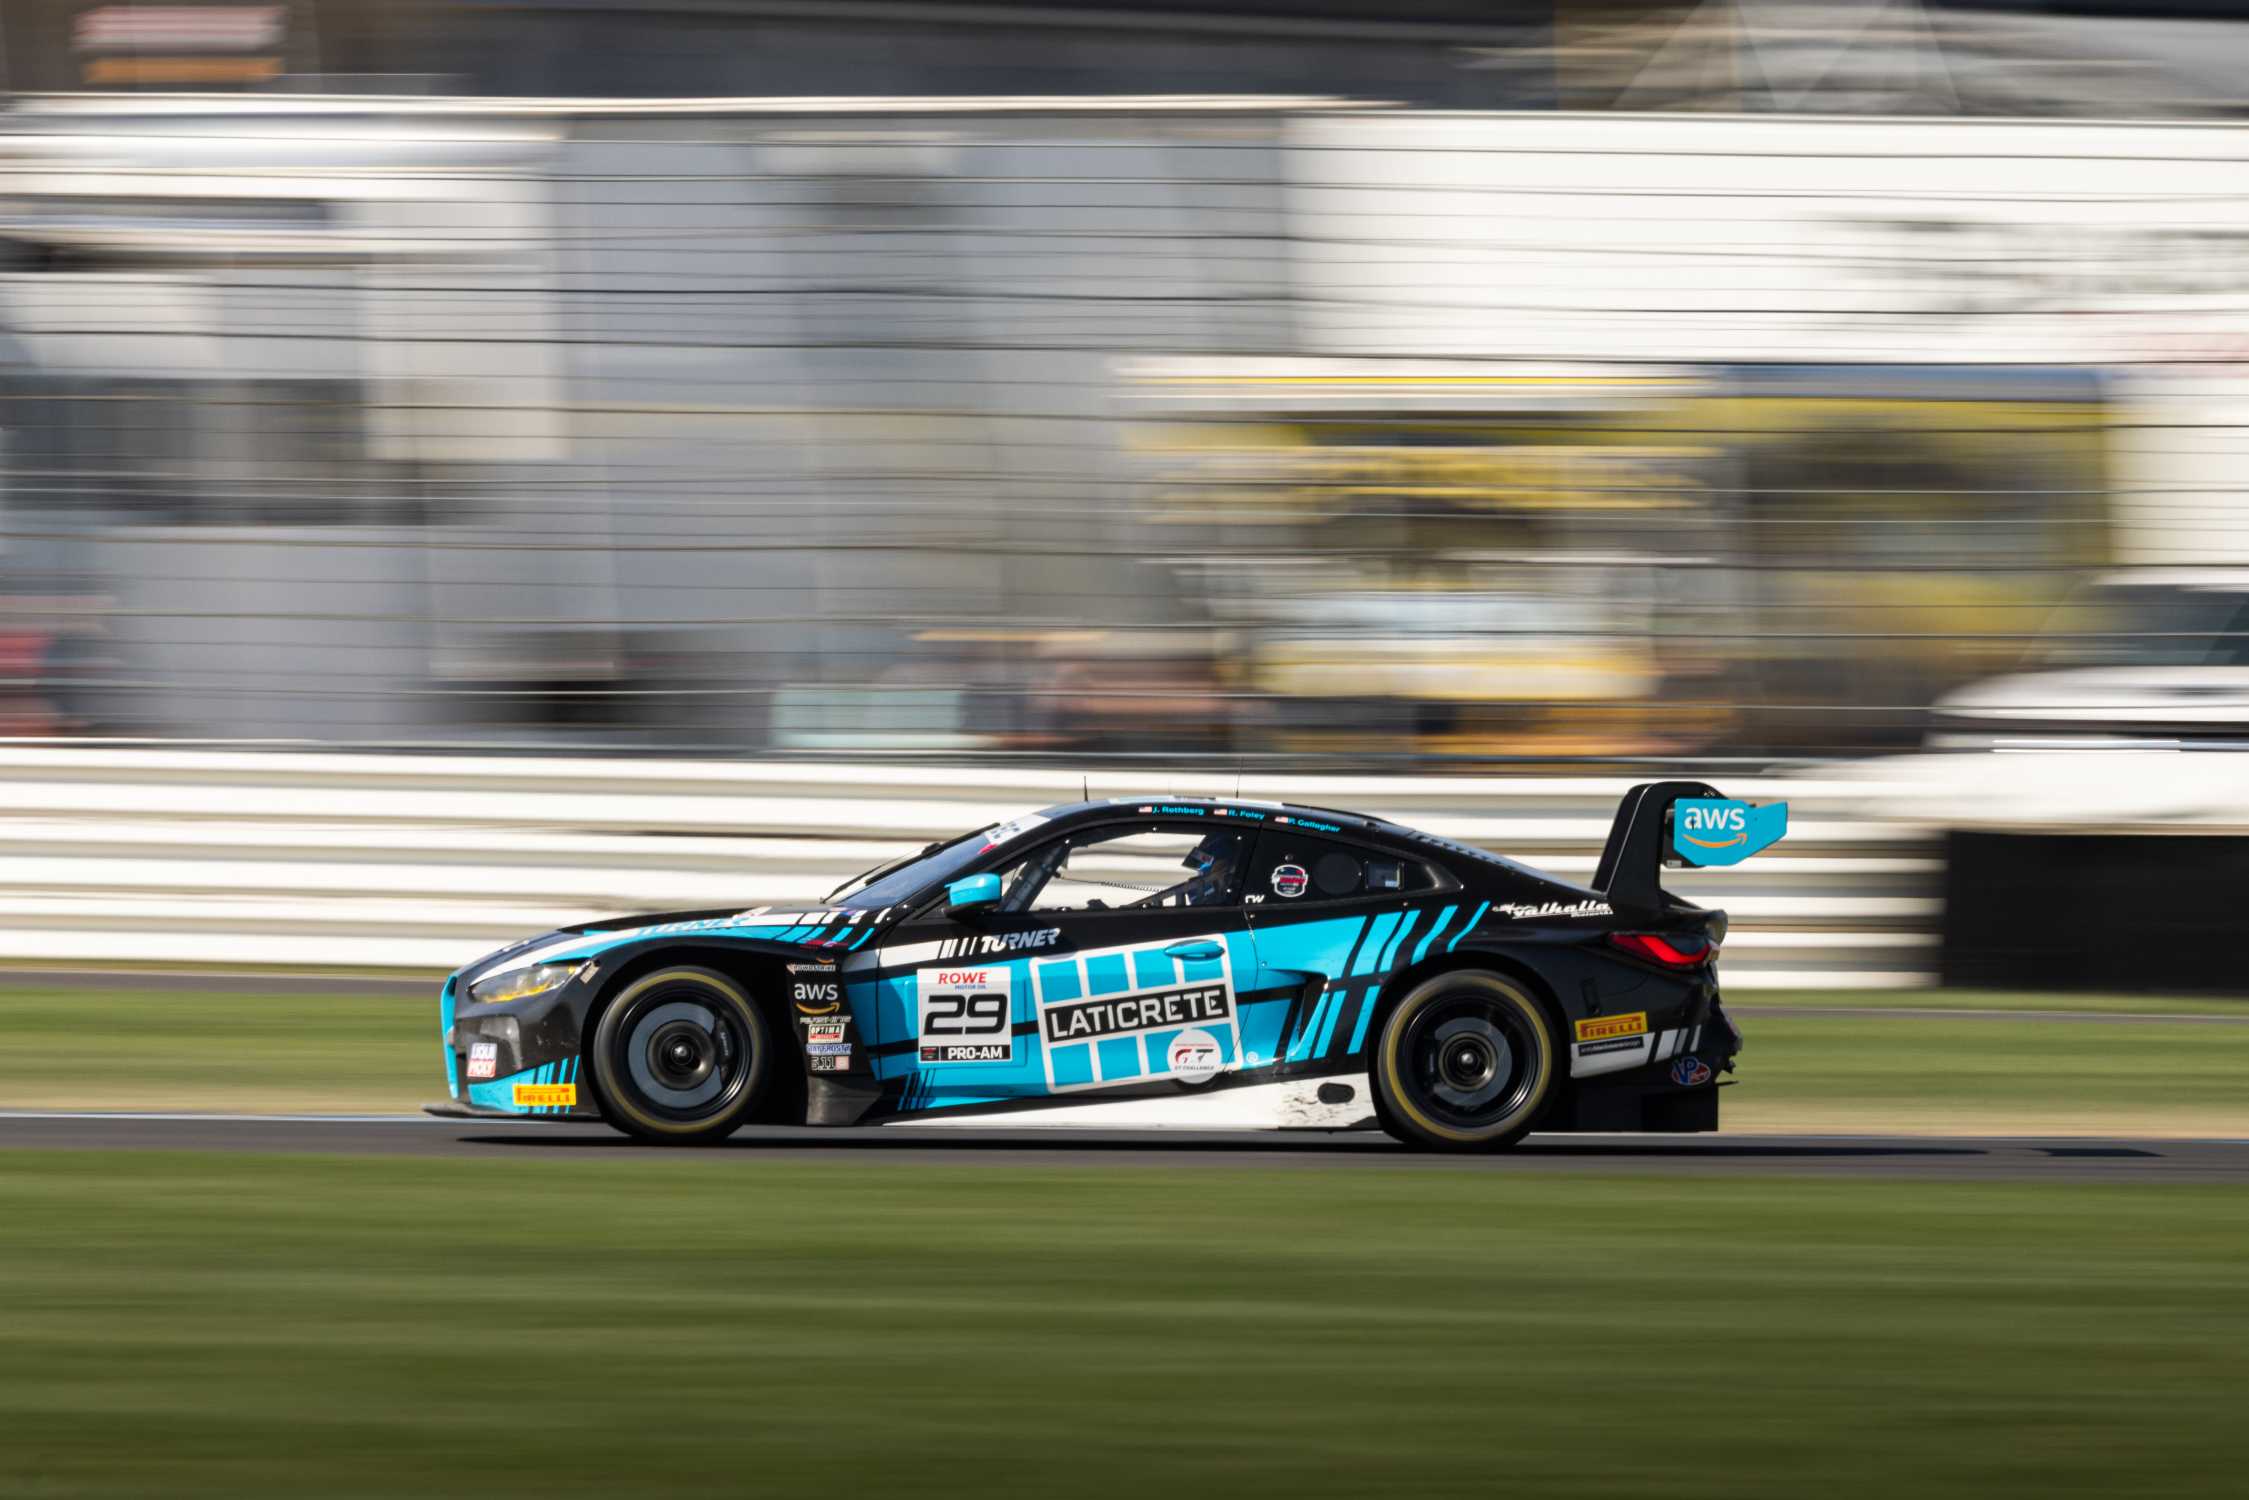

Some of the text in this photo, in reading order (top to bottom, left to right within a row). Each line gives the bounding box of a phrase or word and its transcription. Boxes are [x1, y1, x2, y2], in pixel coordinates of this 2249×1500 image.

[1162, 806, 1205, 816] Rothberg
[1240, 809, 1266, 821] Foley
[1684, 807, 1745, 830] aws
[980, 927, 1061, 954] TURNER
[938, 972, 988, 985] ROWE
[794, 982, 838, 1001] aws
[923, 993, 1008, 1035] 29
[1050, 989, 1223, 1039] LATICRETE
[810, 1026, 841, 1035] OPTIMA
[1580, 1015, 1643, 1038] PIRELLI
[947, 1046, 1003, 1060] PRO-AM
